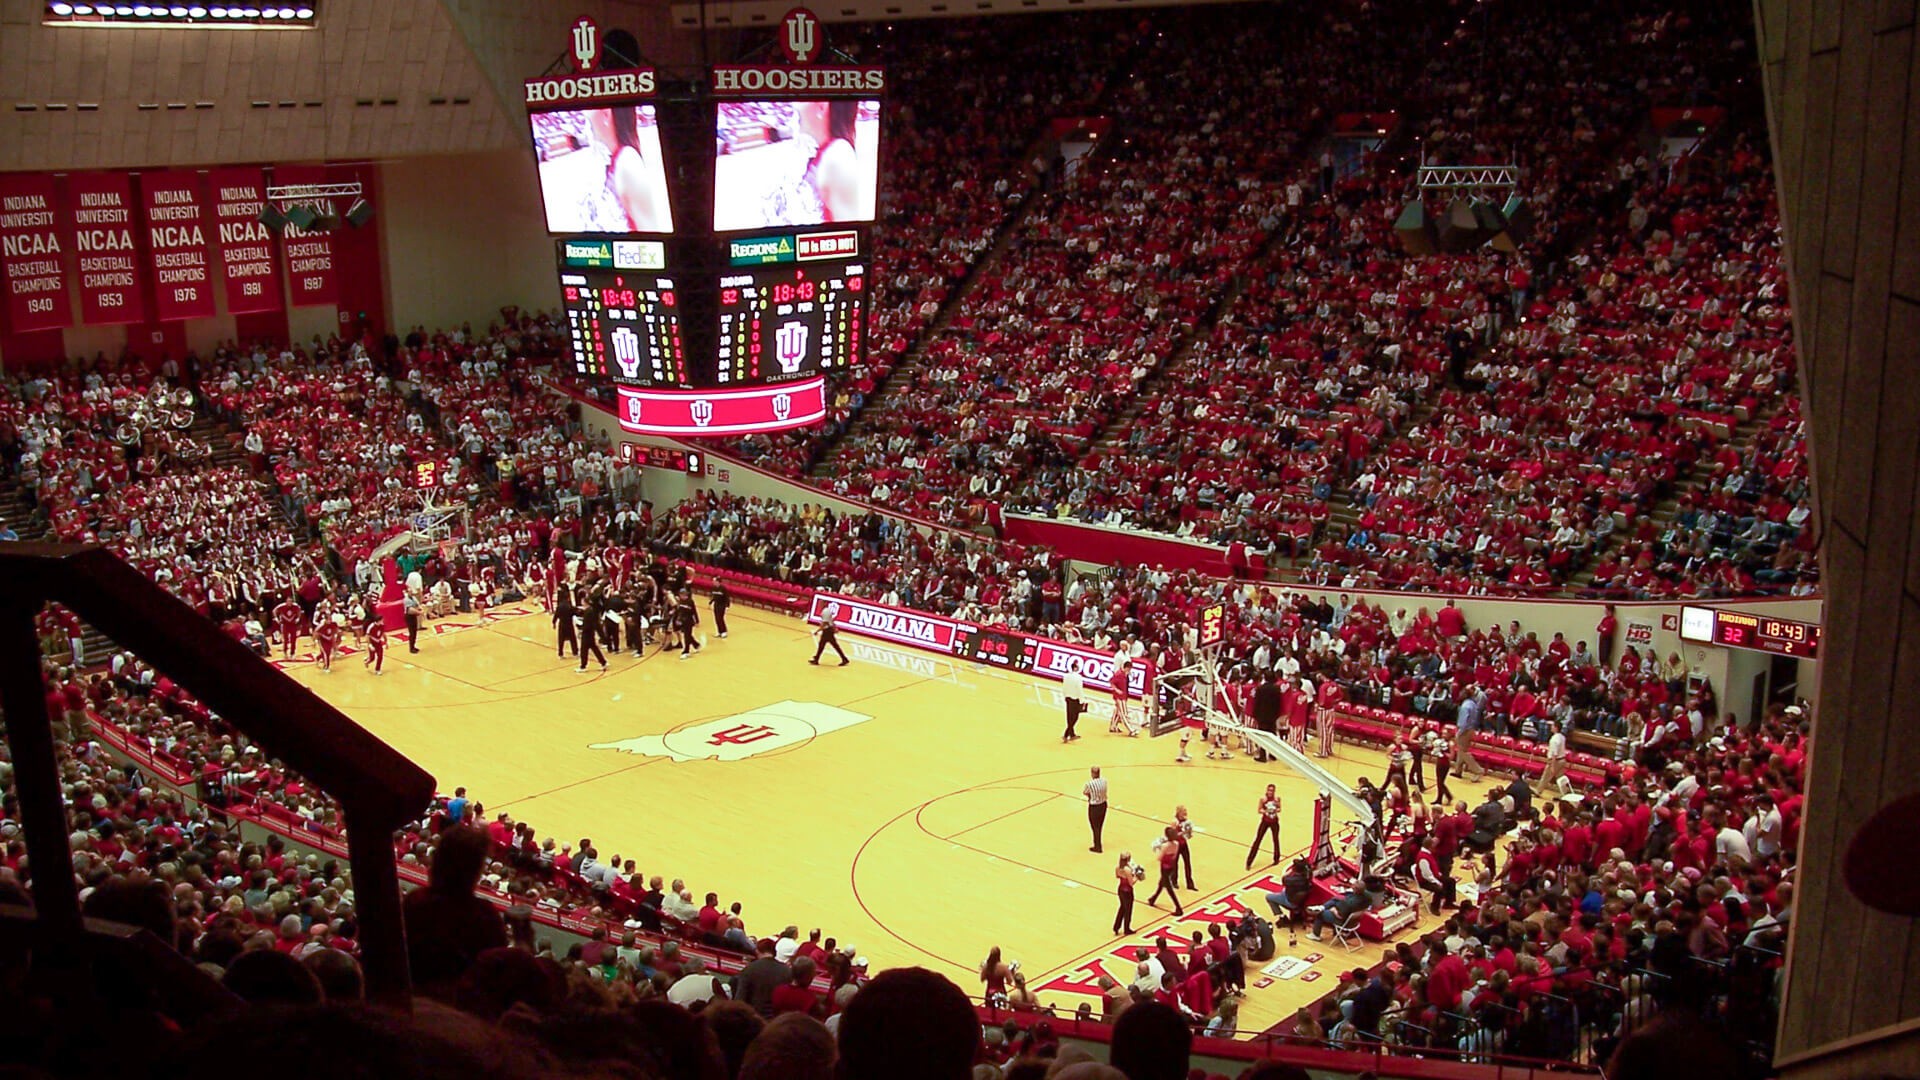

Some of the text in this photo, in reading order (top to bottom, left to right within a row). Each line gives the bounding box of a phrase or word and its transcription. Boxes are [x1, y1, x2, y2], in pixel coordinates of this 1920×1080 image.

[525, 71, 656, 102] HOOSIERS
[713, 68, 885, 91] HOOSIERS
[80, 193, 121, 207] INDIANA
[154, 190, 192, 204] INDIANA
[220, 187, 257, 200] INDIANA
[4, 195, 46, 210] INDIANA
[217, 202, 264, 216] UNIVERSITY
[0, 212, 54, 228] UNIVERSITY
[76, 209, 128, 223] UNIVERSITY
[150, 206, 199, 220] UNIVERSITY
[152, 225, 205, 248] NCAA
[220, 222, 269, 243] NCAA
[284, 221, 331, 239] NC
[2, 232, 61, 256] NCAA
[77, 230, 134, 251] NCAA
[224, 246, 271, 262] BASKETBALL
[288, 242, 331, 257] BASKETBALL
[618, 245, 656, 264] FedEx
[81, 257, 134, 271] BASKETBALL
[155, 252, 205, 267] BASKETBALL
[8, 260, 62, 277] BASKETBALL
[160, 268, 205, 283] CHAMPIONS
[228, 262, 271, 277] CHAMPIONS
[12, 277, 61, 293] CHAMPIONS
[84, 273, 134, 288] CHAMPIONS
[304, 277, 322, 290] 1987
[848, 277, 861, 291] 40
[174, 288, 196, 302] 1976
[243, 282, 261, 295] 1981
[773, 282, 814, 302] 18:43
[98, 293, 123, 307] 1953
[602, 289, 635, 307] 18:43
[722, 289, 738, 304] 32
[820, 293, 826, 303] 0
[28, 298, 53, 312] 1940
[760, 300, 767, 309] 0
[839, 321, 845, 331] 0
[738, 334, 744, 343] 0
[738, 346, 744, 355] 0
[837, 356, 844, 366] 0
[767, 370, 816, 382] DAKTRONICS
[418, 471, 433, 486] 35
[850, 607, 936, 642] INDIANA
[1665, 616, 1676, 629] 4
[1718, 613, 1757, 627] INDIANA
[1202, 619, 1220, 643] 35
[1626, 628, 1652, 639] HD
[1724, 627, 1743, 642] 32
[1766, 622, 1803, 640] 18:43
[1785, 642, 1793, 652] 2
